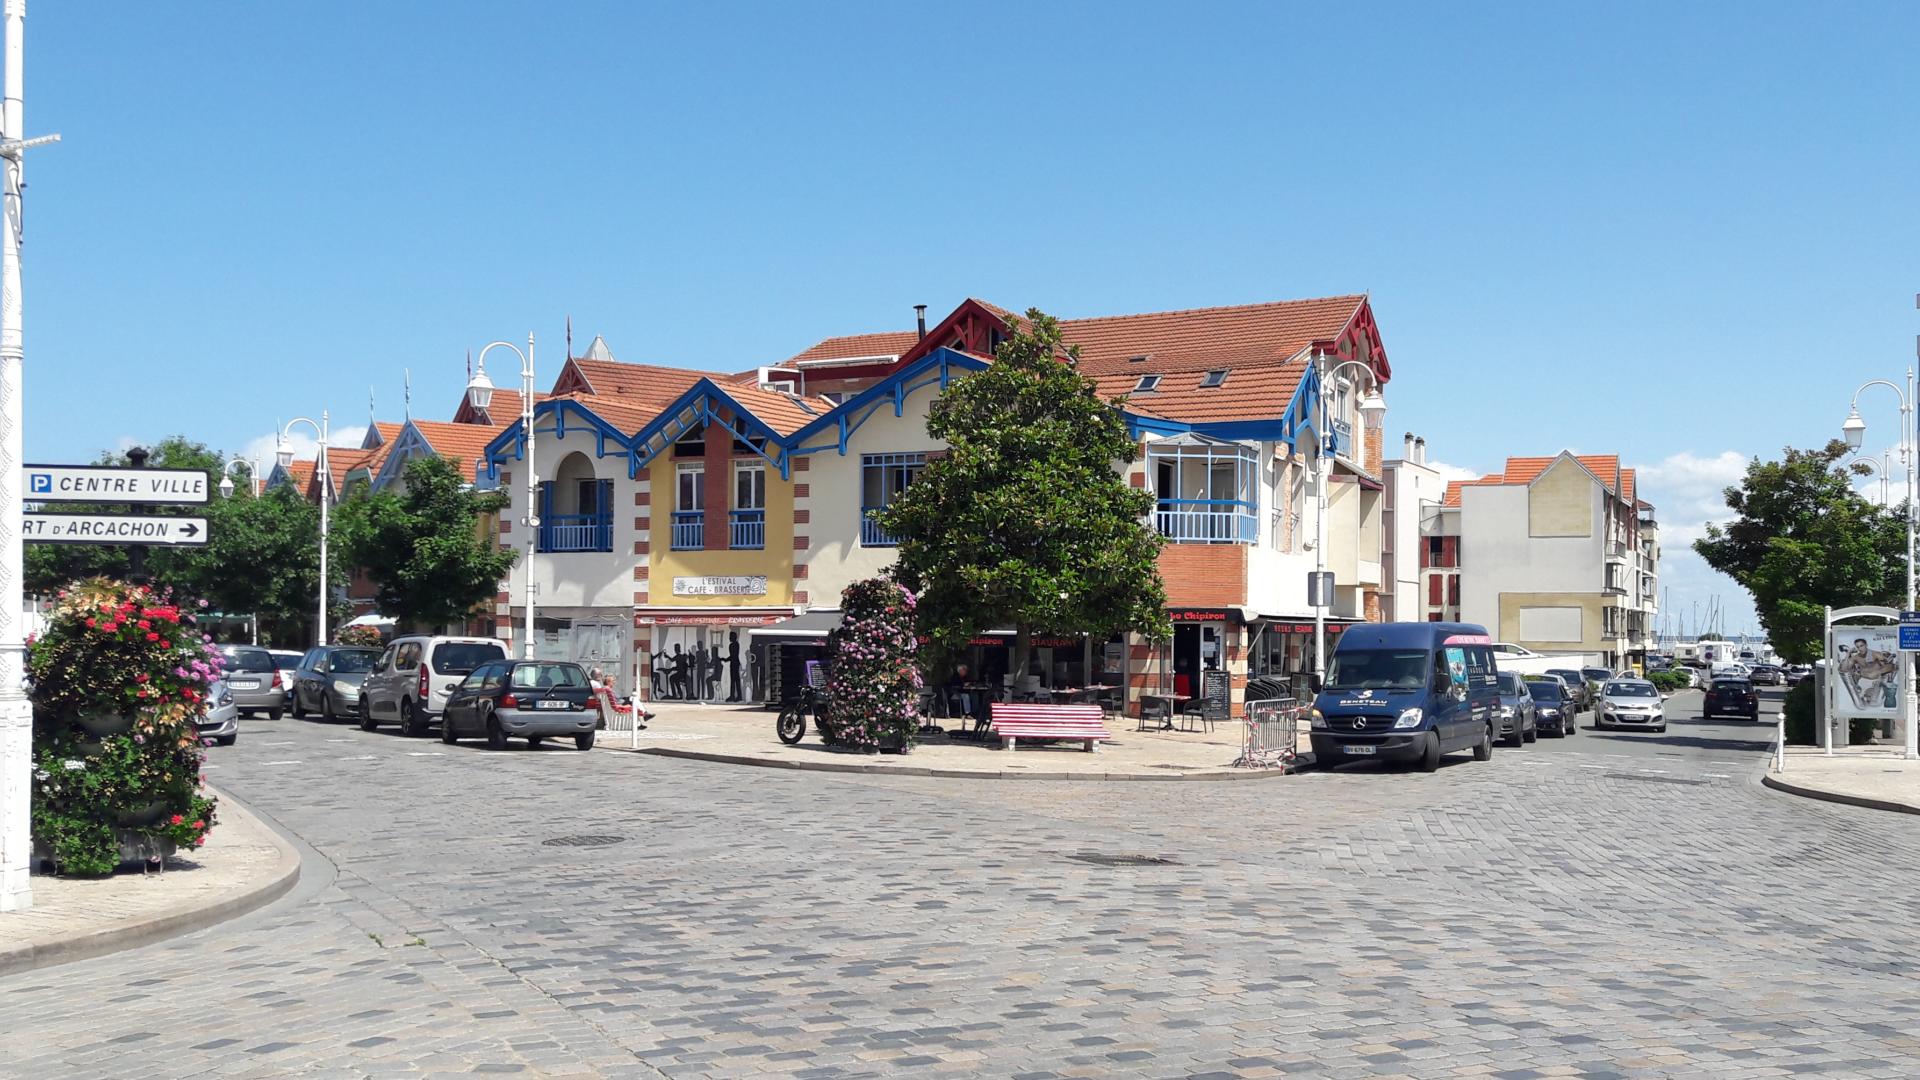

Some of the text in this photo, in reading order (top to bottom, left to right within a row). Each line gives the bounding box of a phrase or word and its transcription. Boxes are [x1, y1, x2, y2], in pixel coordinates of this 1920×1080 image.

[34, 476, 203, 494] P CENTRE VILLE
[22, 520, 46, 535] RT
[702, 577, 737, 585] L'ESTIVAL
[1183, 611, 1226, 622] Chipiron
